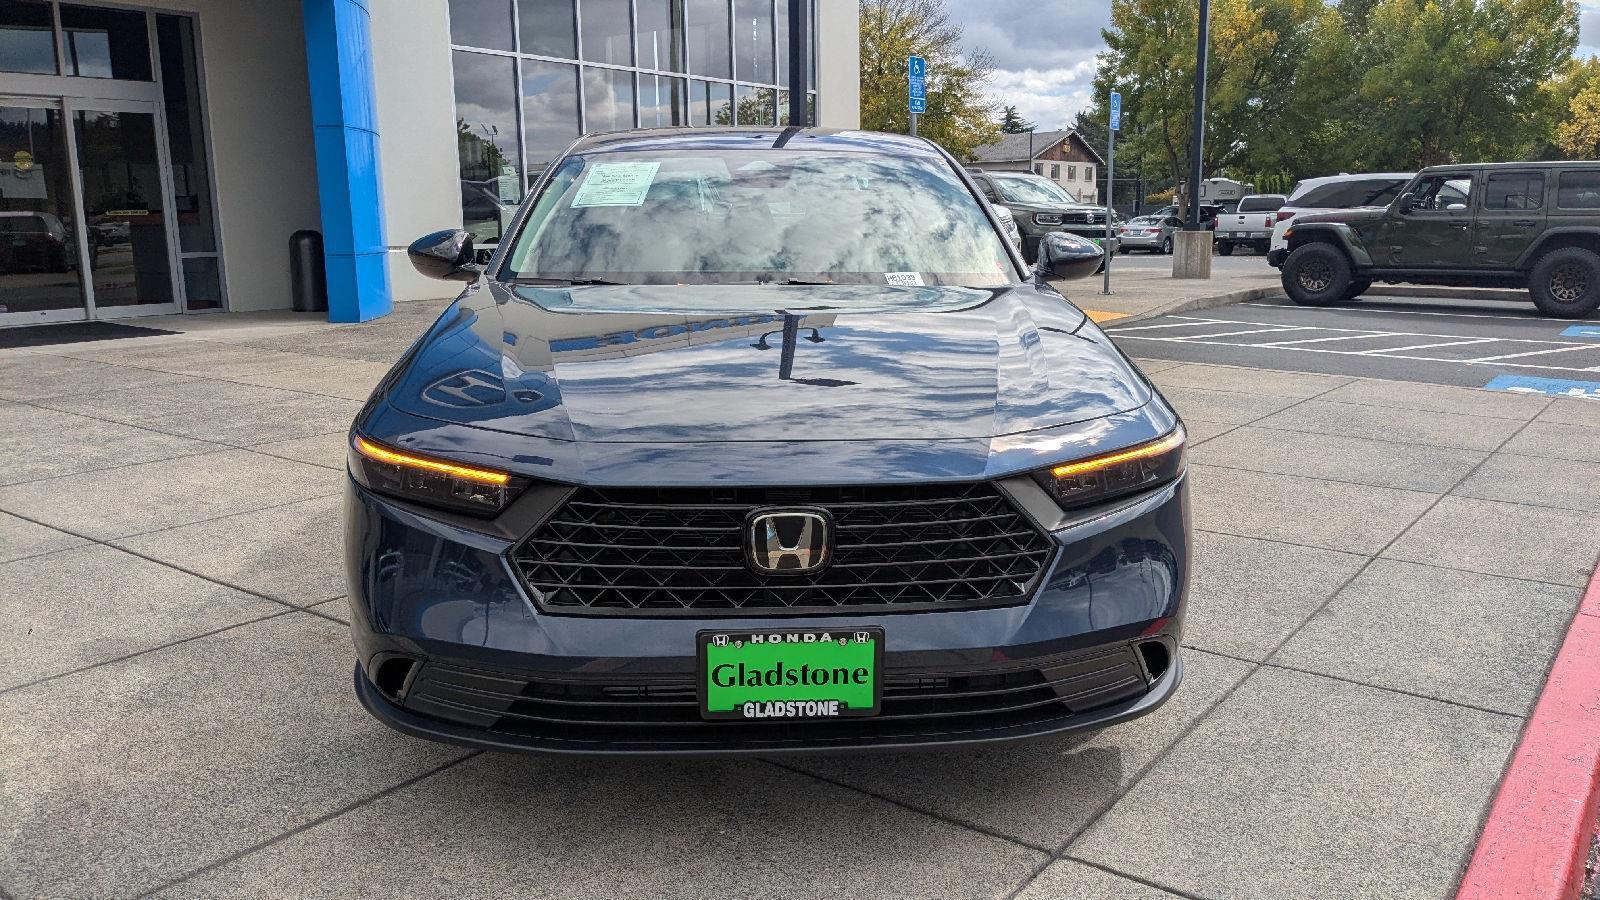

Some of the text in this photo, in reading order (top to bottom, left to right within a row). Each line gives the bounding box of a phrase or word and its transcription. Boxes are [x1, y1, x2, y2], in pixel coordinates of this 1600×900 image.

[751, 632, 832, 644] HONDA
[711, 662, 869, 688] Gladstone
[743, 700, 839, 718] GLADSTONE
